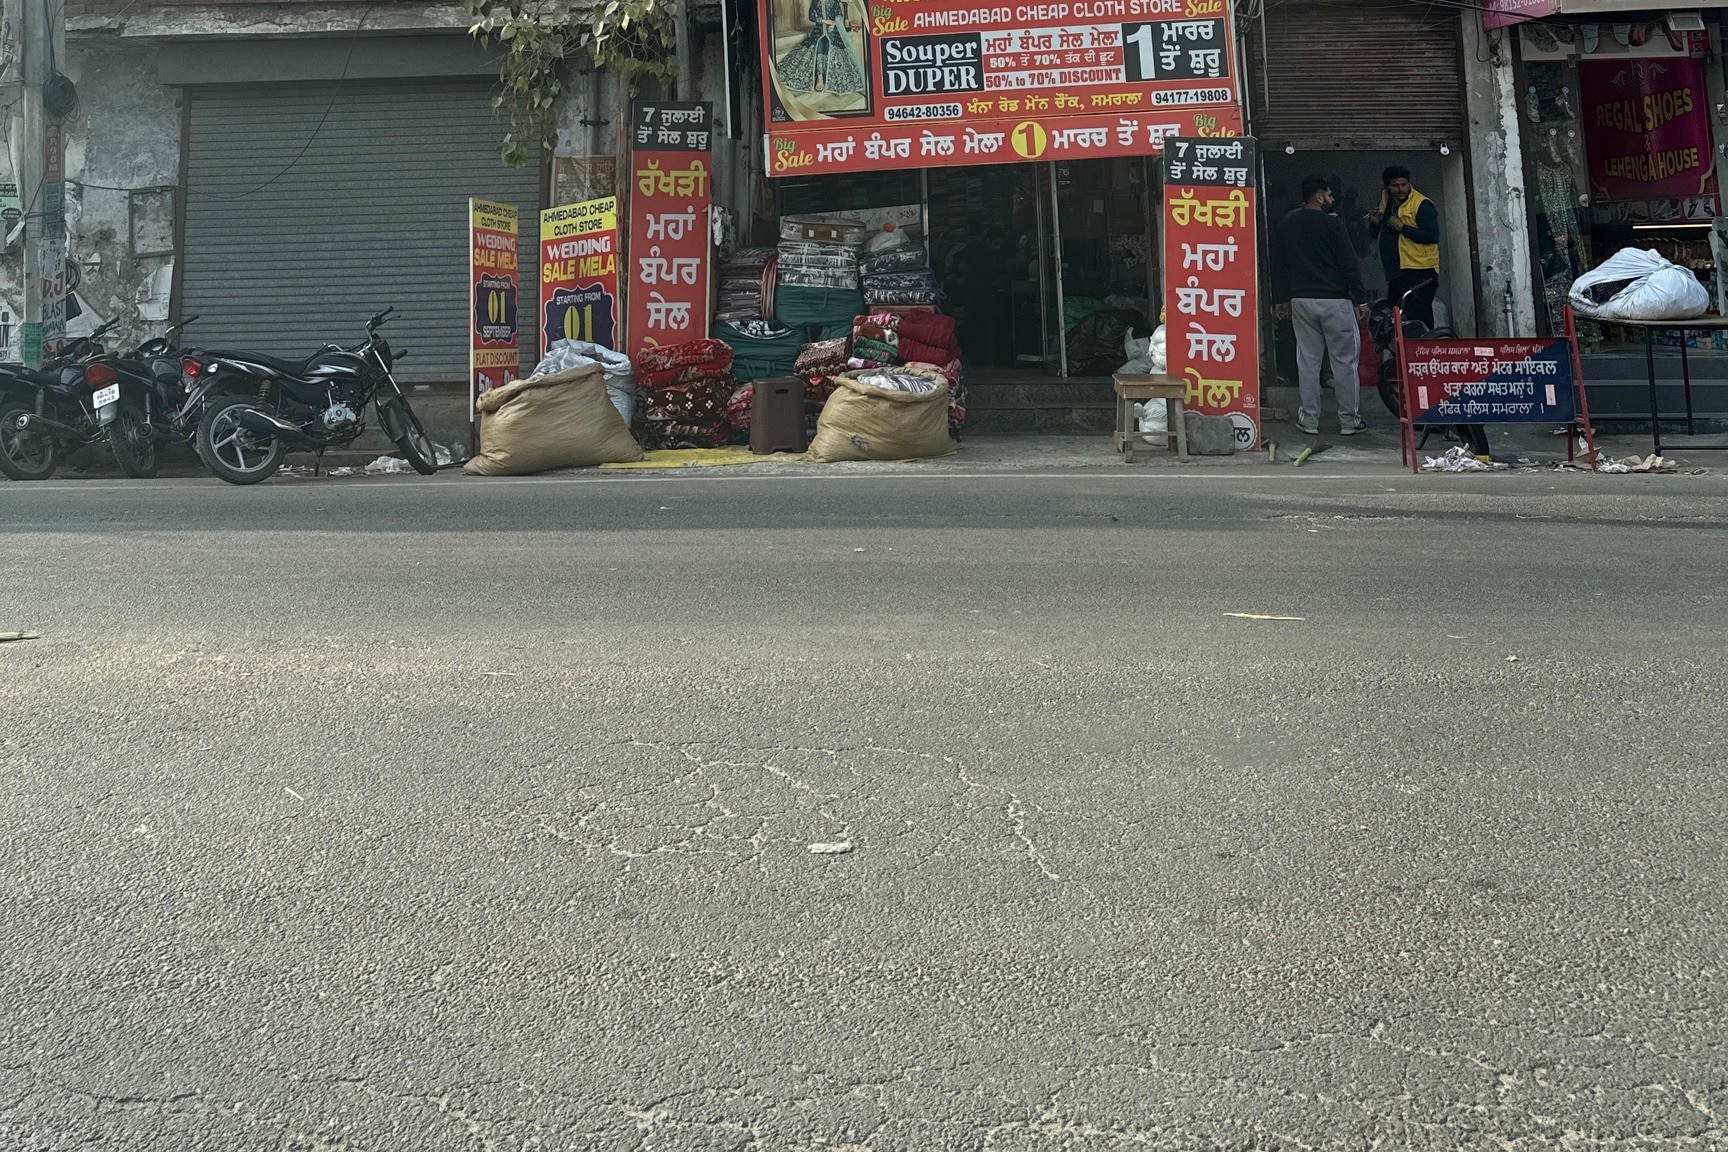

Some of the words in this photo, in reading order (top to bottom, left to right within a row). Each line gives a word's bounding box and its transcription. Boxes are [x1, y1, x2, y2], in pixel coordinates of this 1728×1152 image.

[871, 5, 893, 19] Big
[914, 7, 1011, 28] AHMEDABAD
[1016, 3, 1069, 22] CHEAP
[1073, 0, 1125, 18] CLOTH
[872, 16, 909, 37] Sale
[1161, 21, 1215, 41] ਮਾਰਚ
[985, 33, 1013, 52] ਮਹਾਂ
[1019, 30, 1053, 50] ਬੰਪਰ
[1059, 28, 1084, 48] ਸੇਲ
[1090, 27, 1119, 46] ਮੇਲਾ
[886, 40, 978, 67] Souper
[990, 56, 1016, 68] 50%
[1020, 53, 1030, 66] ਤੋਂ
[1034, 54, 1060, 65] 70%
[1065, 51, 1081, 63] ਤੱਕ
[1084, 49, 1096, 62] ਦੀ
[1126, 24, 1156, 79] 1
[1160, 44, 1181, 70] ਤੋਂ
[1189, 49, 1221, 77] ਸ਼ੁਰੂ
[887, 66, 979, 93] DUPER
[986, 75, 1012, 88] 50%
[1016, 76, 1026, 86] to
[1029, 72, 1056, 85] 70%
[1059, 68, 1121, 83] DISCOUNT
[967, 97, 993, 114] ਖੰਨਾ
[999, 95, 1020, 111] ਰੋਡ
[1091, 92, 1142, 107] ਸਮਰਾਲਾ
[1155, 90, 1228, 104] 94177-19808
[643, 107, 655, 123] 7
[661, 106, 705, 126] ਜੁਲਾਈ
[888, 105, 960, 120] 94642-80356
[1596, 98, 1642, 133] REGAL
[1643, 87, 1693, 131] SHOES
[1193, 114, 1217, 129] Big
[637, 125, 653, 143] ਤੋਂ
[657, 126, 681, 144] ਸੇਲ
[686, 131, 709, 150] ਸ਼ੁਰੂ
[773, 138, 797, 152] Big
[816, 136, 856, 162] ਮਹਾਂ
[864, 132, 912, 160] ਬੰਪਰ
[920, 130, 955, 156] ਸੇਲ
[963, 128, 1005, 154] ਮੇਲਾ
[1018, 123, 1037, 156] 1
[1052, 127, 1108, 149] ਮਾਰਚ
[1117, 118, 1139, 146] ਤੋਂ
[774, 150, 814, 172] Sale
[1176, 142, 1189, 158] 7
[1195, 141, 1243, 161] ਜੁਲਾਈ
[1170, 160, 1186, 179] ਤੋਂ
[1192, 162, 1218, 180] ਸੇਲ
[1223, 168, 1248, 187] ਸ਼ੁਰੂ
[1605, 153, 1657, 182] LEHENGA
[1657, 147, 1699, 179] HOUSE
[637, 159, 707, 197] ਰੱਖੜੀ
[474, 202, 502, 217] AHMEDABAD
[503, 208, 518, 219] CHEAP
[543, 205, 588, 224] AHMEDABAD
[589, 201, 615, 215] CHEAP
[1169, 188, 1249, 227] ਰੱਖੜੀ
[481, 217, 496, 228] CLOTH
[497, 219, 511, 230] STORE
[554, 221, 578, 236] CLOTH
[579, 218, 603, 233] STORE
[646, 206, 696, 241] ਮਹਾਂ
[476, 232, 516, 252] WEDDING
[547, 236, 611, 260] WEDDING
[474, 248, 496, 268] SALE
[497, 251, 518, 270] MELA
[1181, 236, 1238, 271] ਮਹਾਂ
[543, 259, 576, 283] SALE
[579, 254, 616, 279] MELA
[640, 245, 700, 285] ਬੰਪਰ
[487, 290, 507, 324] 01
[556, 294, 583, 306] STARTING
[584, 291, 602, 302] FROM
[1176, 276, 1245, 317] ਬੰਪਰ
[42, 299, 65, 321] BLAST
[646, 292, 691, 330] ਸੇਲ
[483, 326, 511, 338] SEPTEMBER
[563, 304, 594, 342] 01
[1186, 322, 1237, 362] ਸੇਲ
[476, 352, 489, 366] FLAT
[490, 352, 517, 366] DISCOUNT
[1470, 358, 1490, 374] ਅਤੇ
[1184, 367, 1242, 408] ਮੇਲਾ
[1526, 376, 1534, 395] ਹੈ
[1491, 403, 1534, 414] ਸਮਰਾਲਾ
